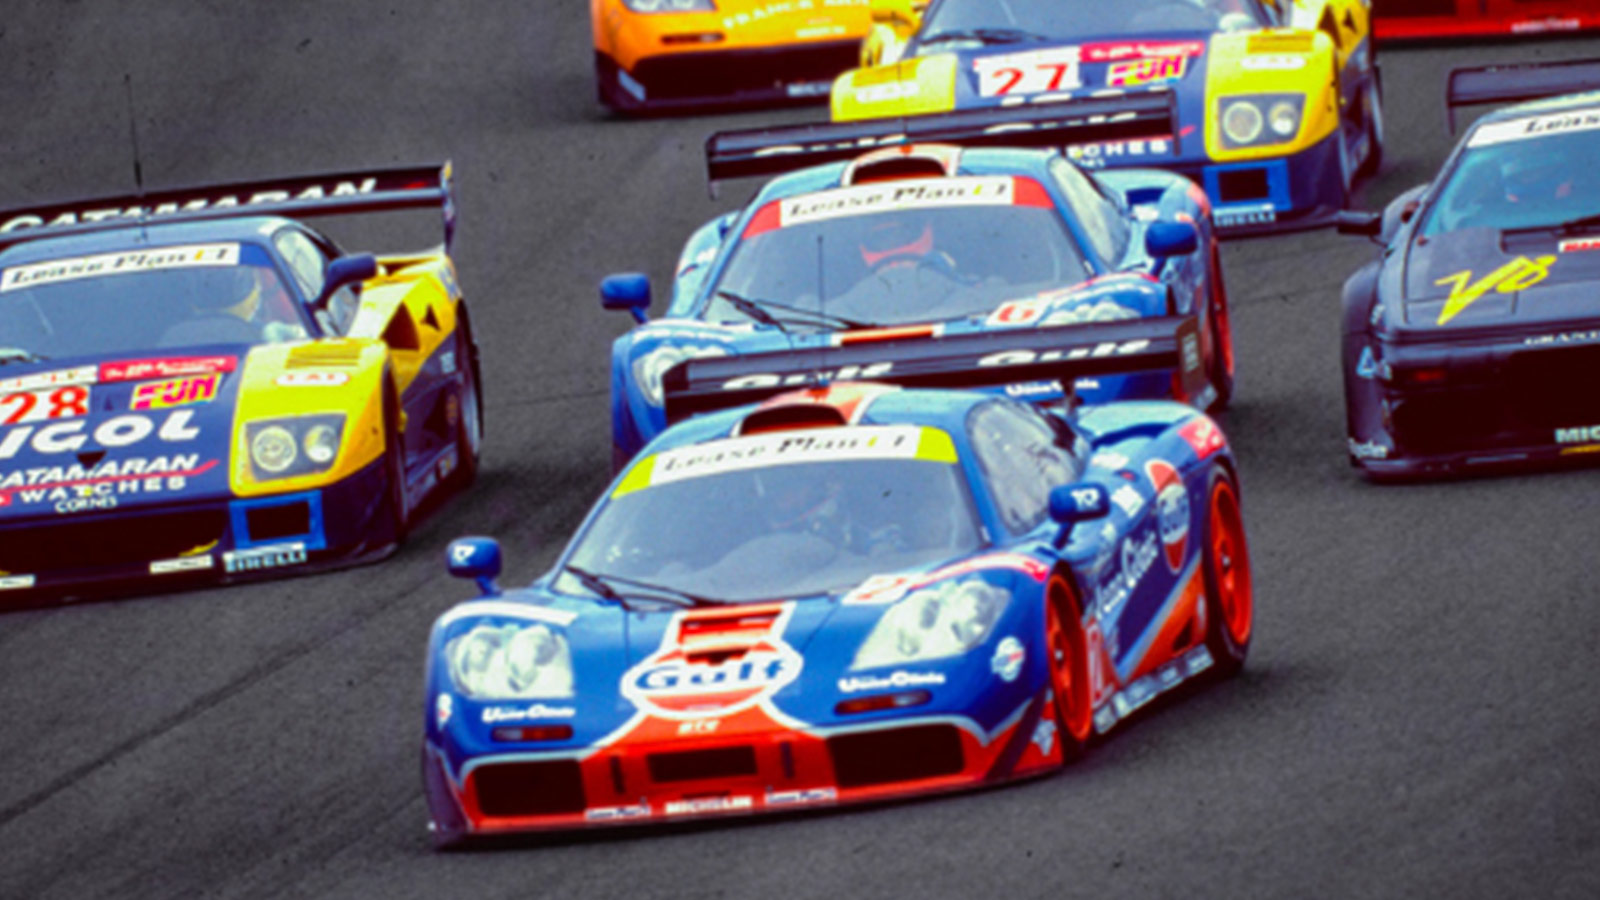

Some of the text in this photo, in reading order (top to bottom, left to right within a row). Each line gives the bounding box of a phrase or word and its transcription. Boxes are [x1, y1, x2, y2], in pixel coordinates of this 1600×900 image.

[990, 62, 1069, 97] 27
[1433, 254, 1558, 326] V8
[0, 385, 89, 425] 28
[132, 374, 219, 411] FUN
[0, 453, 200, 491] ATAMARAN
[19, 474, 187, 504] WATCHES
[634, 659, 785, 691] Gulf
